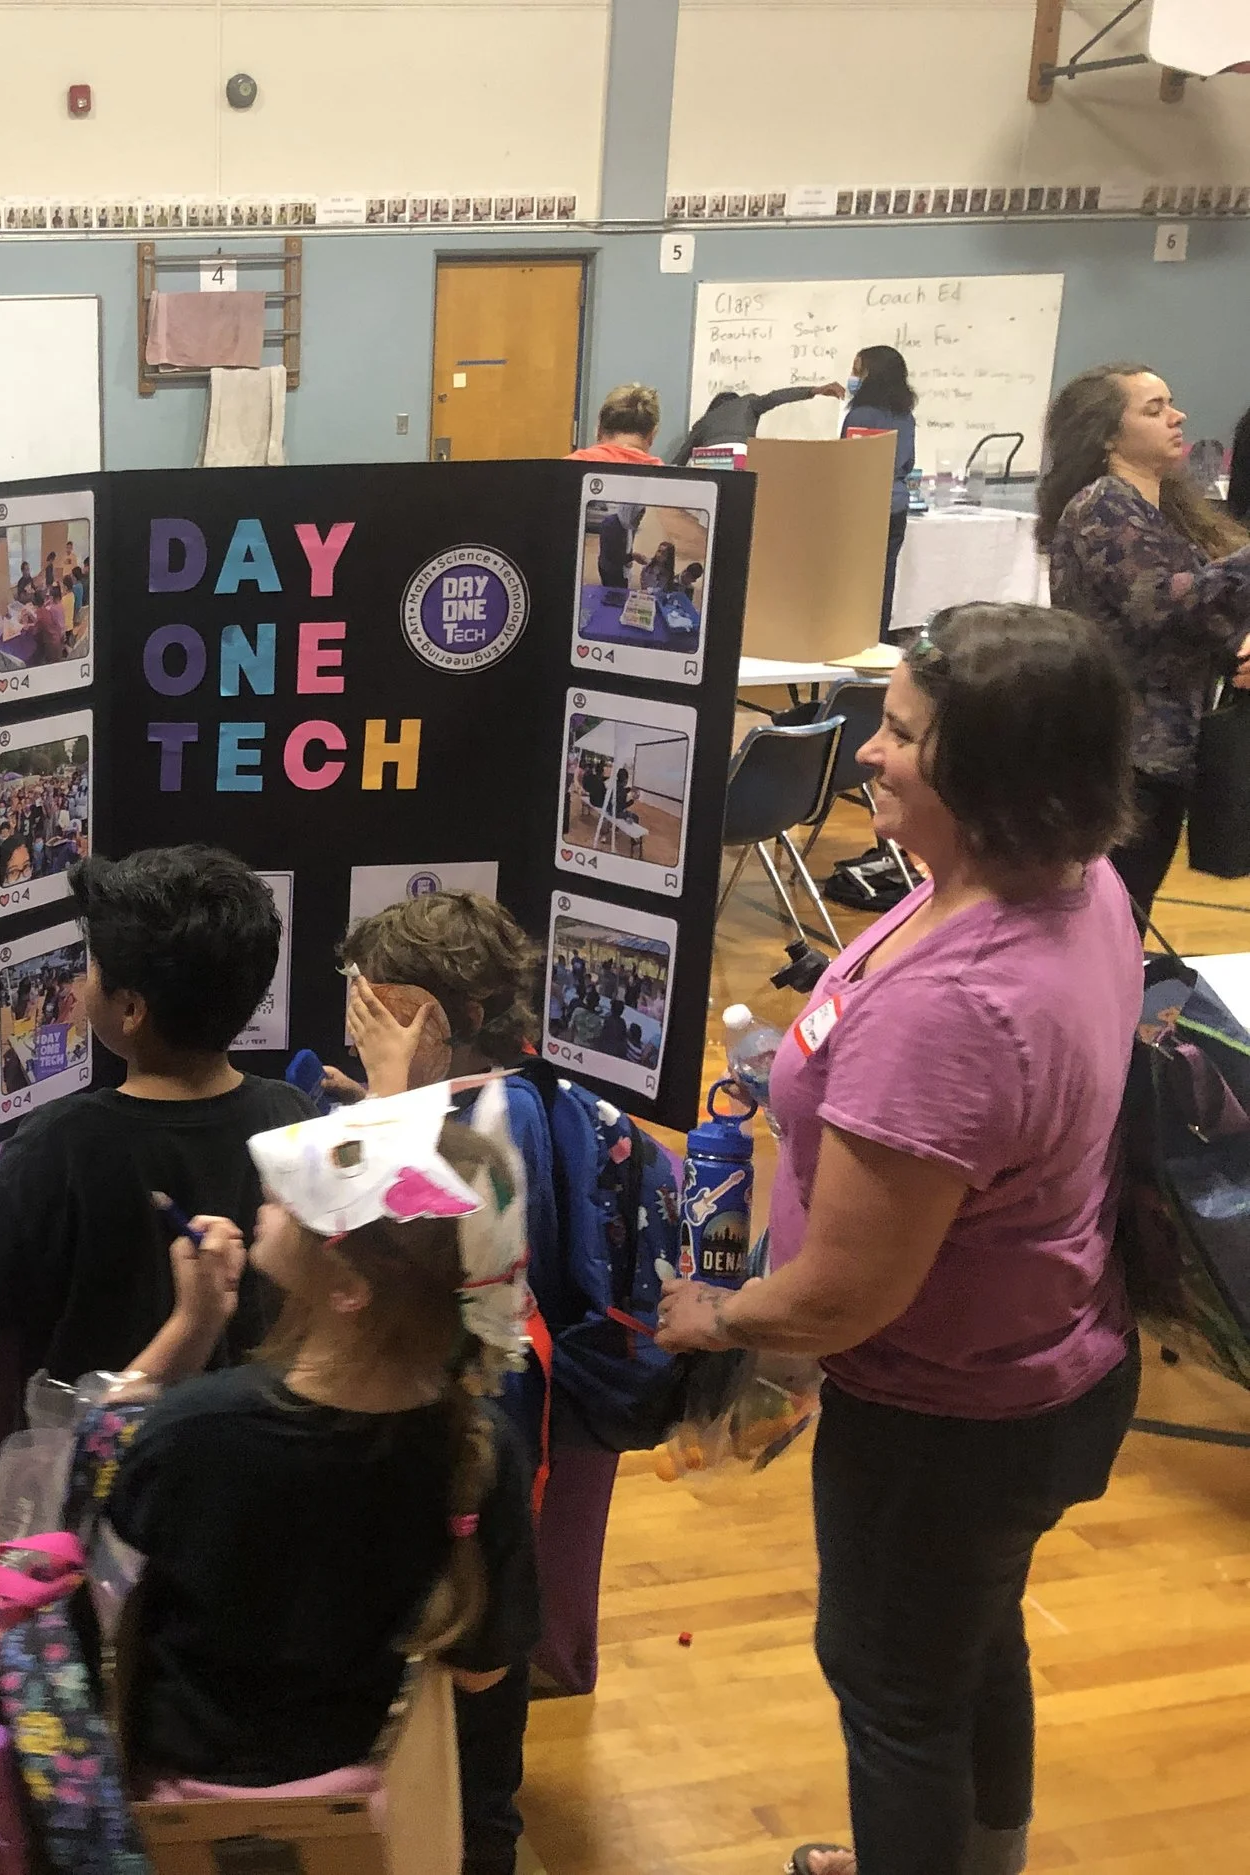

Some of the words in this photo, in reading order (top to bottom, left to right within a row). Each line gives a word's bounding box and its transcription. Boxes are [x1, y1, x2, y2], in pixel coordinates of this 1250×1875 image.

[673, 244, 682, 260] 5
[1167, 233, 1177, 250] 6
[212, 265, 225, 285] 4
[866, 285, 926, 306] Coach
[938, 282, 962, 303] Ed
[149, 518, 356, 597] DAY
[437, 551, 491, 569] Science
[408, 570, 433, 604] Math
[442, 575, 489, 599] DAY
[442, 599, 487, 622] ONE
[497, 562, 524, 641] Technology
[407, 615, 420, 636] Art
[143, 622, 347, 698] ONE
[421, 641, 501, 667] Engineering
[147, 719, 422, 792] TECH
[40, 1043, 60, 1056] ONE
[41, 1032, 61, 1044] DAY
[40, 1055, 64, 1067] TECH
